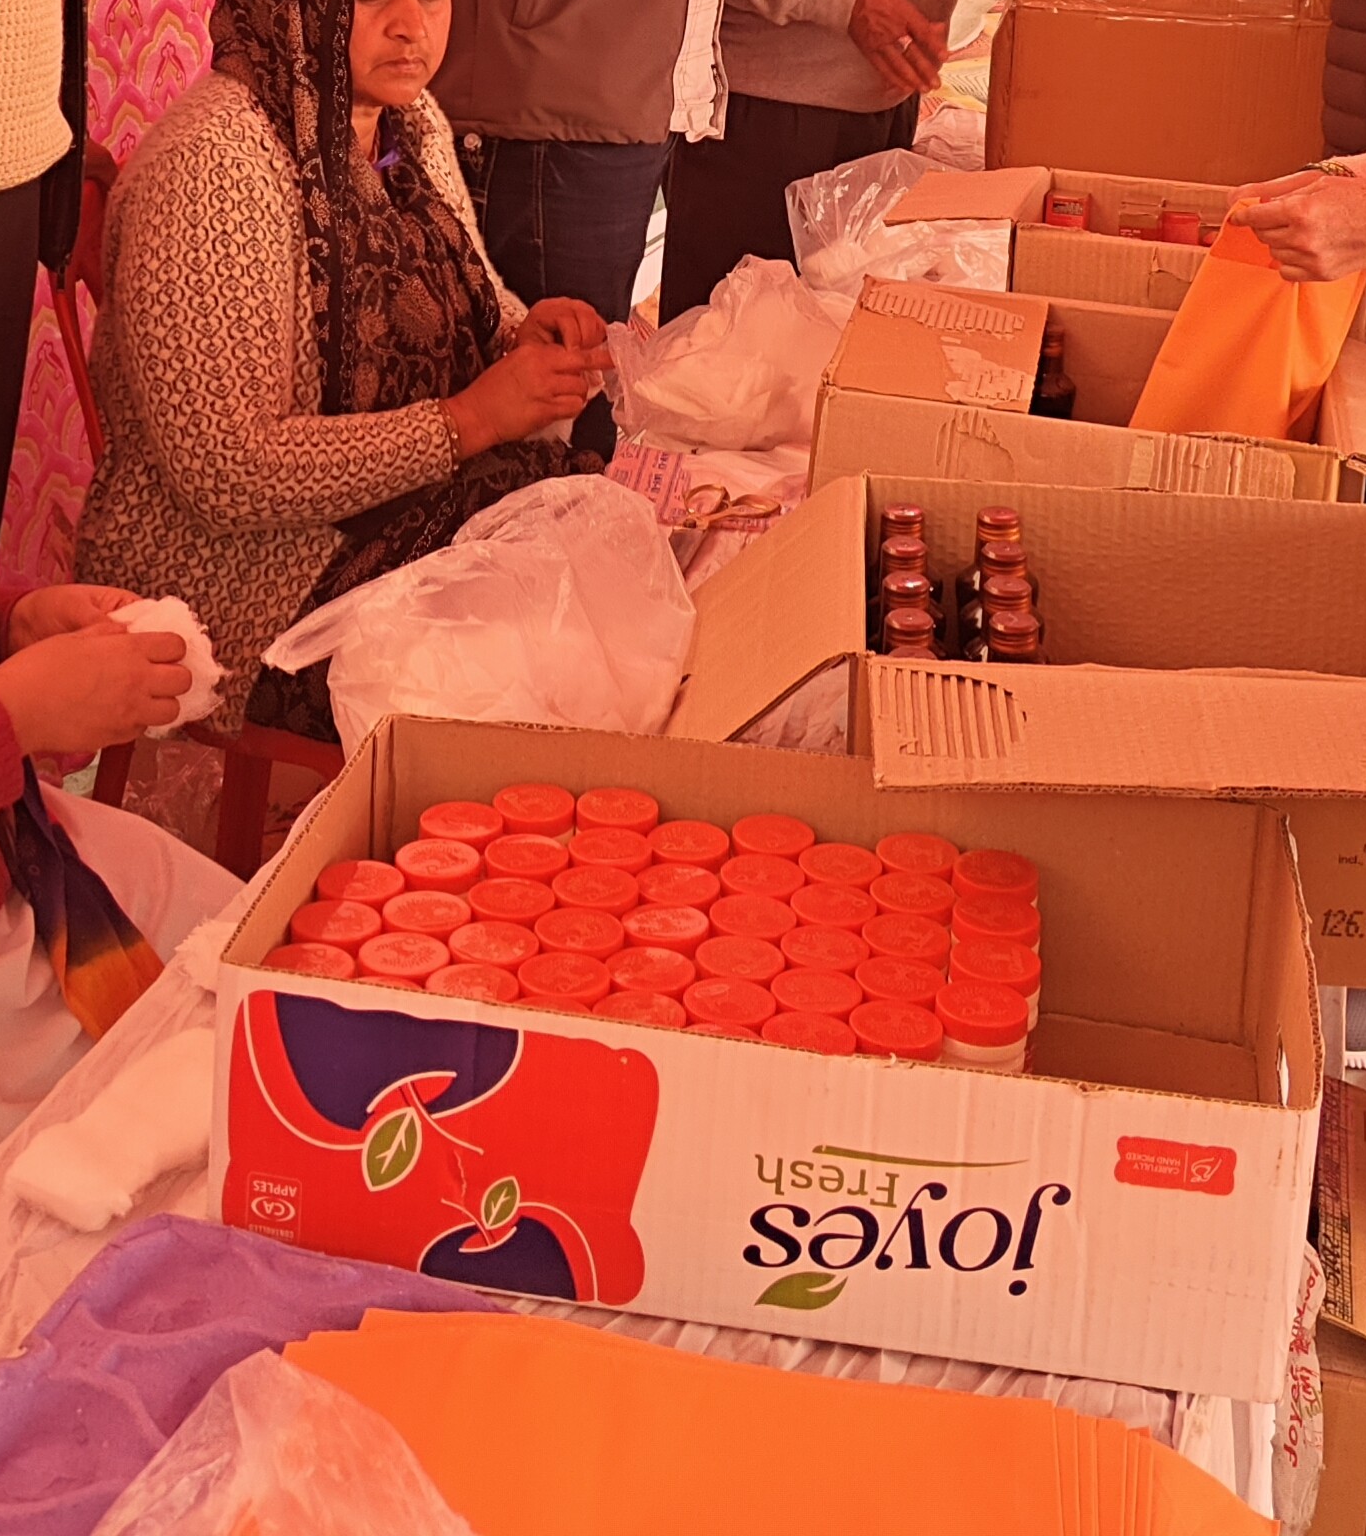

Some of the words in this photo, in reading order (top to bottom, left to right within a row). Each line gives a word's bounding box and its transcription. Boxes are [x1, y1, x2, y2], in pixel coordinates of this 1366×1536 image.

[253, 1180, 297, 1197] APPLES
[754, 1153, 900, 1209] Fresh
[262, 1200, 285, 1216] CA
[743, 1181, 1071, 1296] joyes
